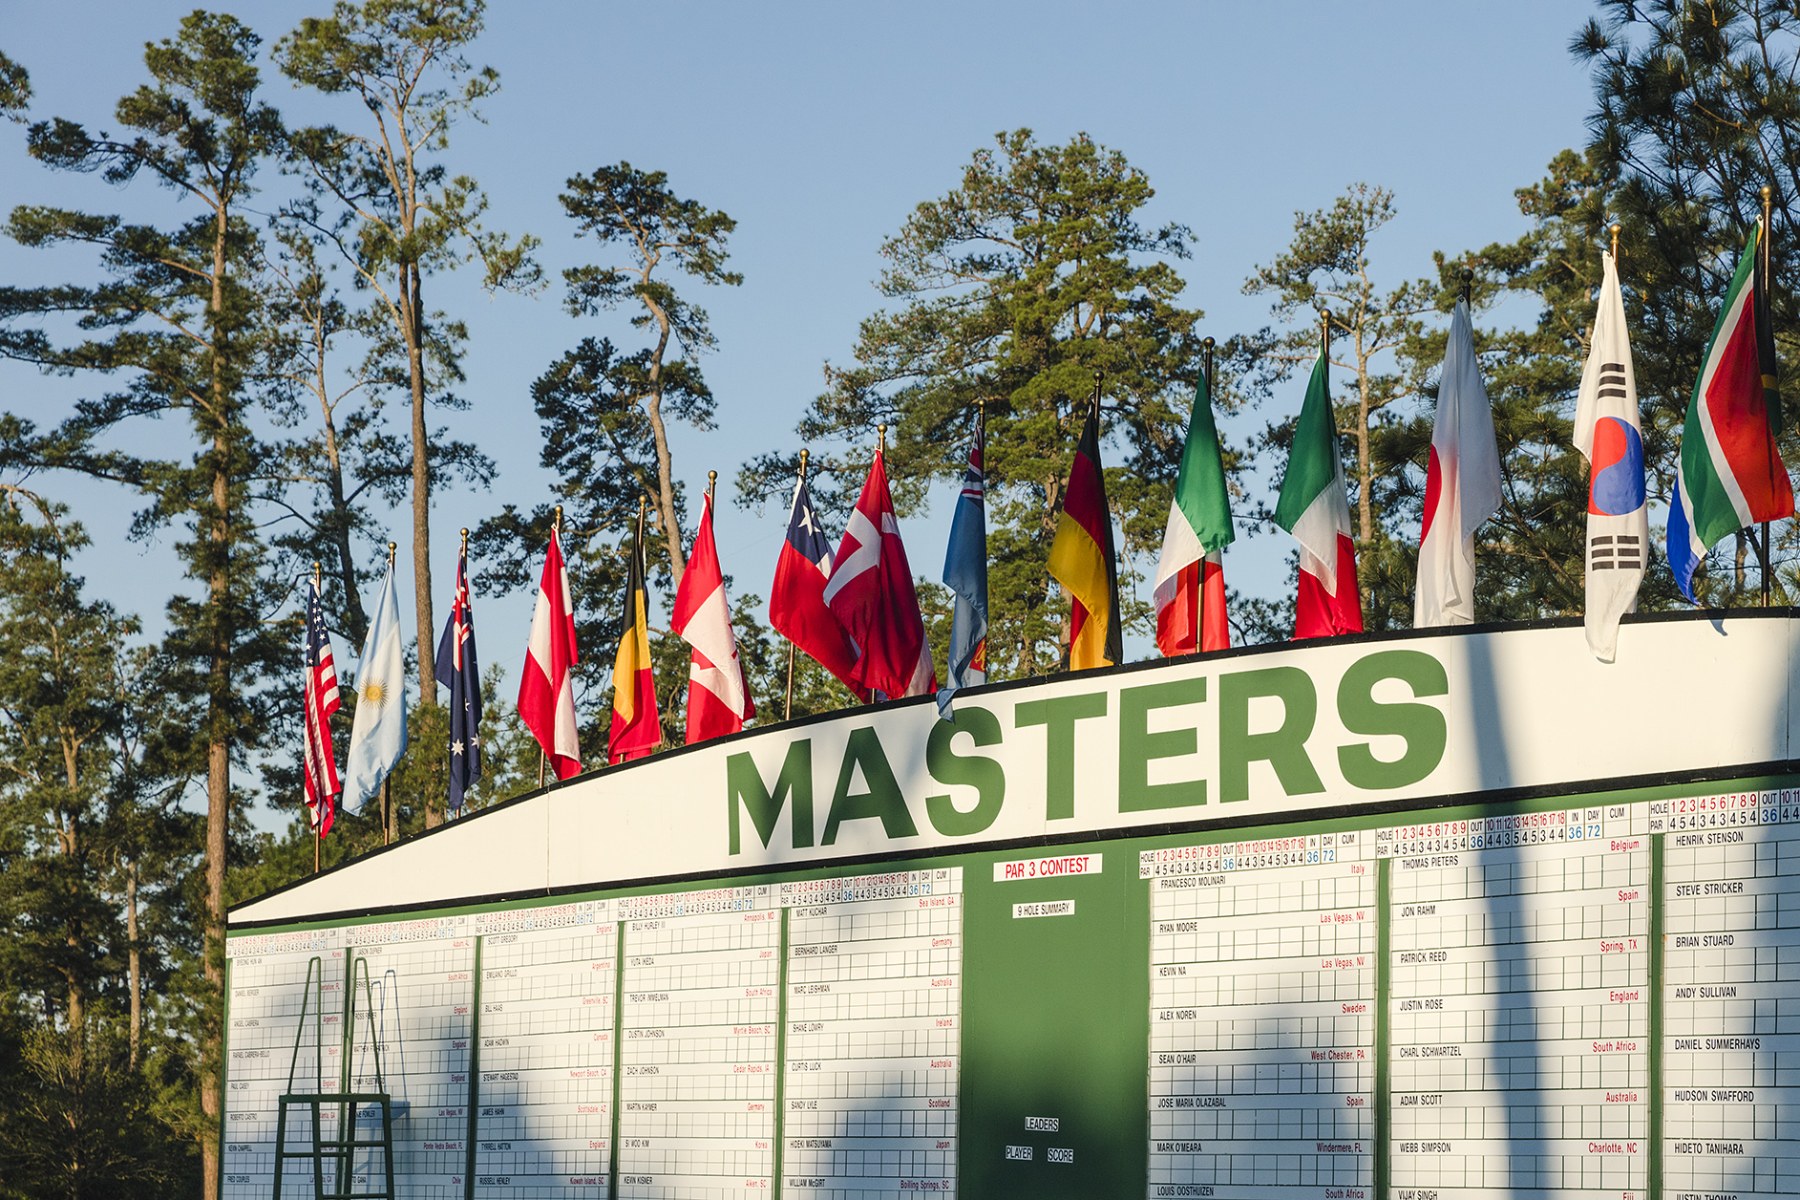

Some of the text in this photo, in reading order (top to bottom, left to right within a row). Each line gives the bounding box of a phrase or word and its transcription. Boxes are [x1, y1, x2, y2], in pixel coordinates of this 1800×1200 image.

[725, 649, 1449, 856] MASTERS
[1650, 790, 1800, 814] HOLE 1 2 3 4 5 6 7 8 9 OUT 10 11
[1650, 807, 1799, 830] PAR 4 5 4 3 4 3 4 5 4 36 4 4
[1676, 831, 1744, 846] HENRIK STENSON
[1610, 839, 1640, 852] Belgium
[1005, 857, 1089, 879] PAR 3 CONTEST
[1402, 856, 1459, 869] THOMAS PIETERS
[1351, 864, 1365, 875] Italy
[1161, 876, 1226, 889] FRANCESCO MOLINARI
[1676, 882, 1744, 896] STEVE STRICKER
[1618, 890, 1639, 902] Spain
[1018, 903, 1069, 916] 9 HOLE SUMMARY
[1401, 905, 1436, 917] JON RAHM
[1320, 913, 1332, 924] Las
[1356, 911, 1365, 921] NV
[1159, 922, 1198, 933] RYAN MOORE
[932, 939, 952, 947] Germany
[1629, 939, 1637, 950] TX
[1676, 935, 1734, 948] BRIAN STUARD
[1321, 959, 1332, 968] Las
[1356, 956, 1364, 967] NV
[1400, 951, 1447, 963] PATRICK REED
[1159, 966, 1187, 977] KEVIN NA
[931, 978, 952, 987] Australia
[1610, 990, 1639, 1002] England
[1676, 987, 1737, 998] ANDY SULLIVAN
[1342, 1004, 1366, 1014] Sweden
[1400, 1000, 1443, 1011] JUSTIN ROSE
[1160, 1010, 1197, 1020] ALEX NOREN
[1592, 1041, 1636, 1053] South Africa
[1675, 1038, 1760, 1050] DANIEL SUMMERHAYS
[1311, 1051, 1326, 1060] West
[1357, 1049, 1365, 1059] PA
[1400, 1046, 1462, 1058] CHARL SCHWARTZEL
[931, 1059, 952, 1068] Australia
[1158, 1054, 1196, 1064] SEAN O'HAIR
[1346, 1096, 1364, 1107] Spain
[1400, 1095, 1442, 1106] ADAM SCOTT
[1606, 1092, 1637, 1103] Australia
[1675, 1090, 1754, 1102] HUDSON SWAFFORD
[928, 1099, 950, 1108] Scotland
[1158, 1097, 1226, 1108] JOSE MARIA OLAZABAL
[1026, 1119, 1058, 1131] LEADERS
[936, 1140, 950, 1149] Japan
[1157, 1143, 1202, 1152] MARK O'MEARA
[1355, 1143, 1362, 1152] FL
[1400, 1143, 1451, 1152] WEBB SIMPSON
[1626, 1143, 1637, 1153] NC
[1675, 1143, 1744, 1154] HIDETO TANIHARA
[1007, 1147, 1032, 1159] PLAYER
[1048, 1149, 1073, 1161] SCORE
[942, 1180, 949, 1189] SC
[1157, 1186, 1214, 1196] LOUIS OOSTHUIZEN
[1325, 1189, 1364, 1199] South Africa
[1399, 1190, 1438, 1200] VIJAY SINGH
